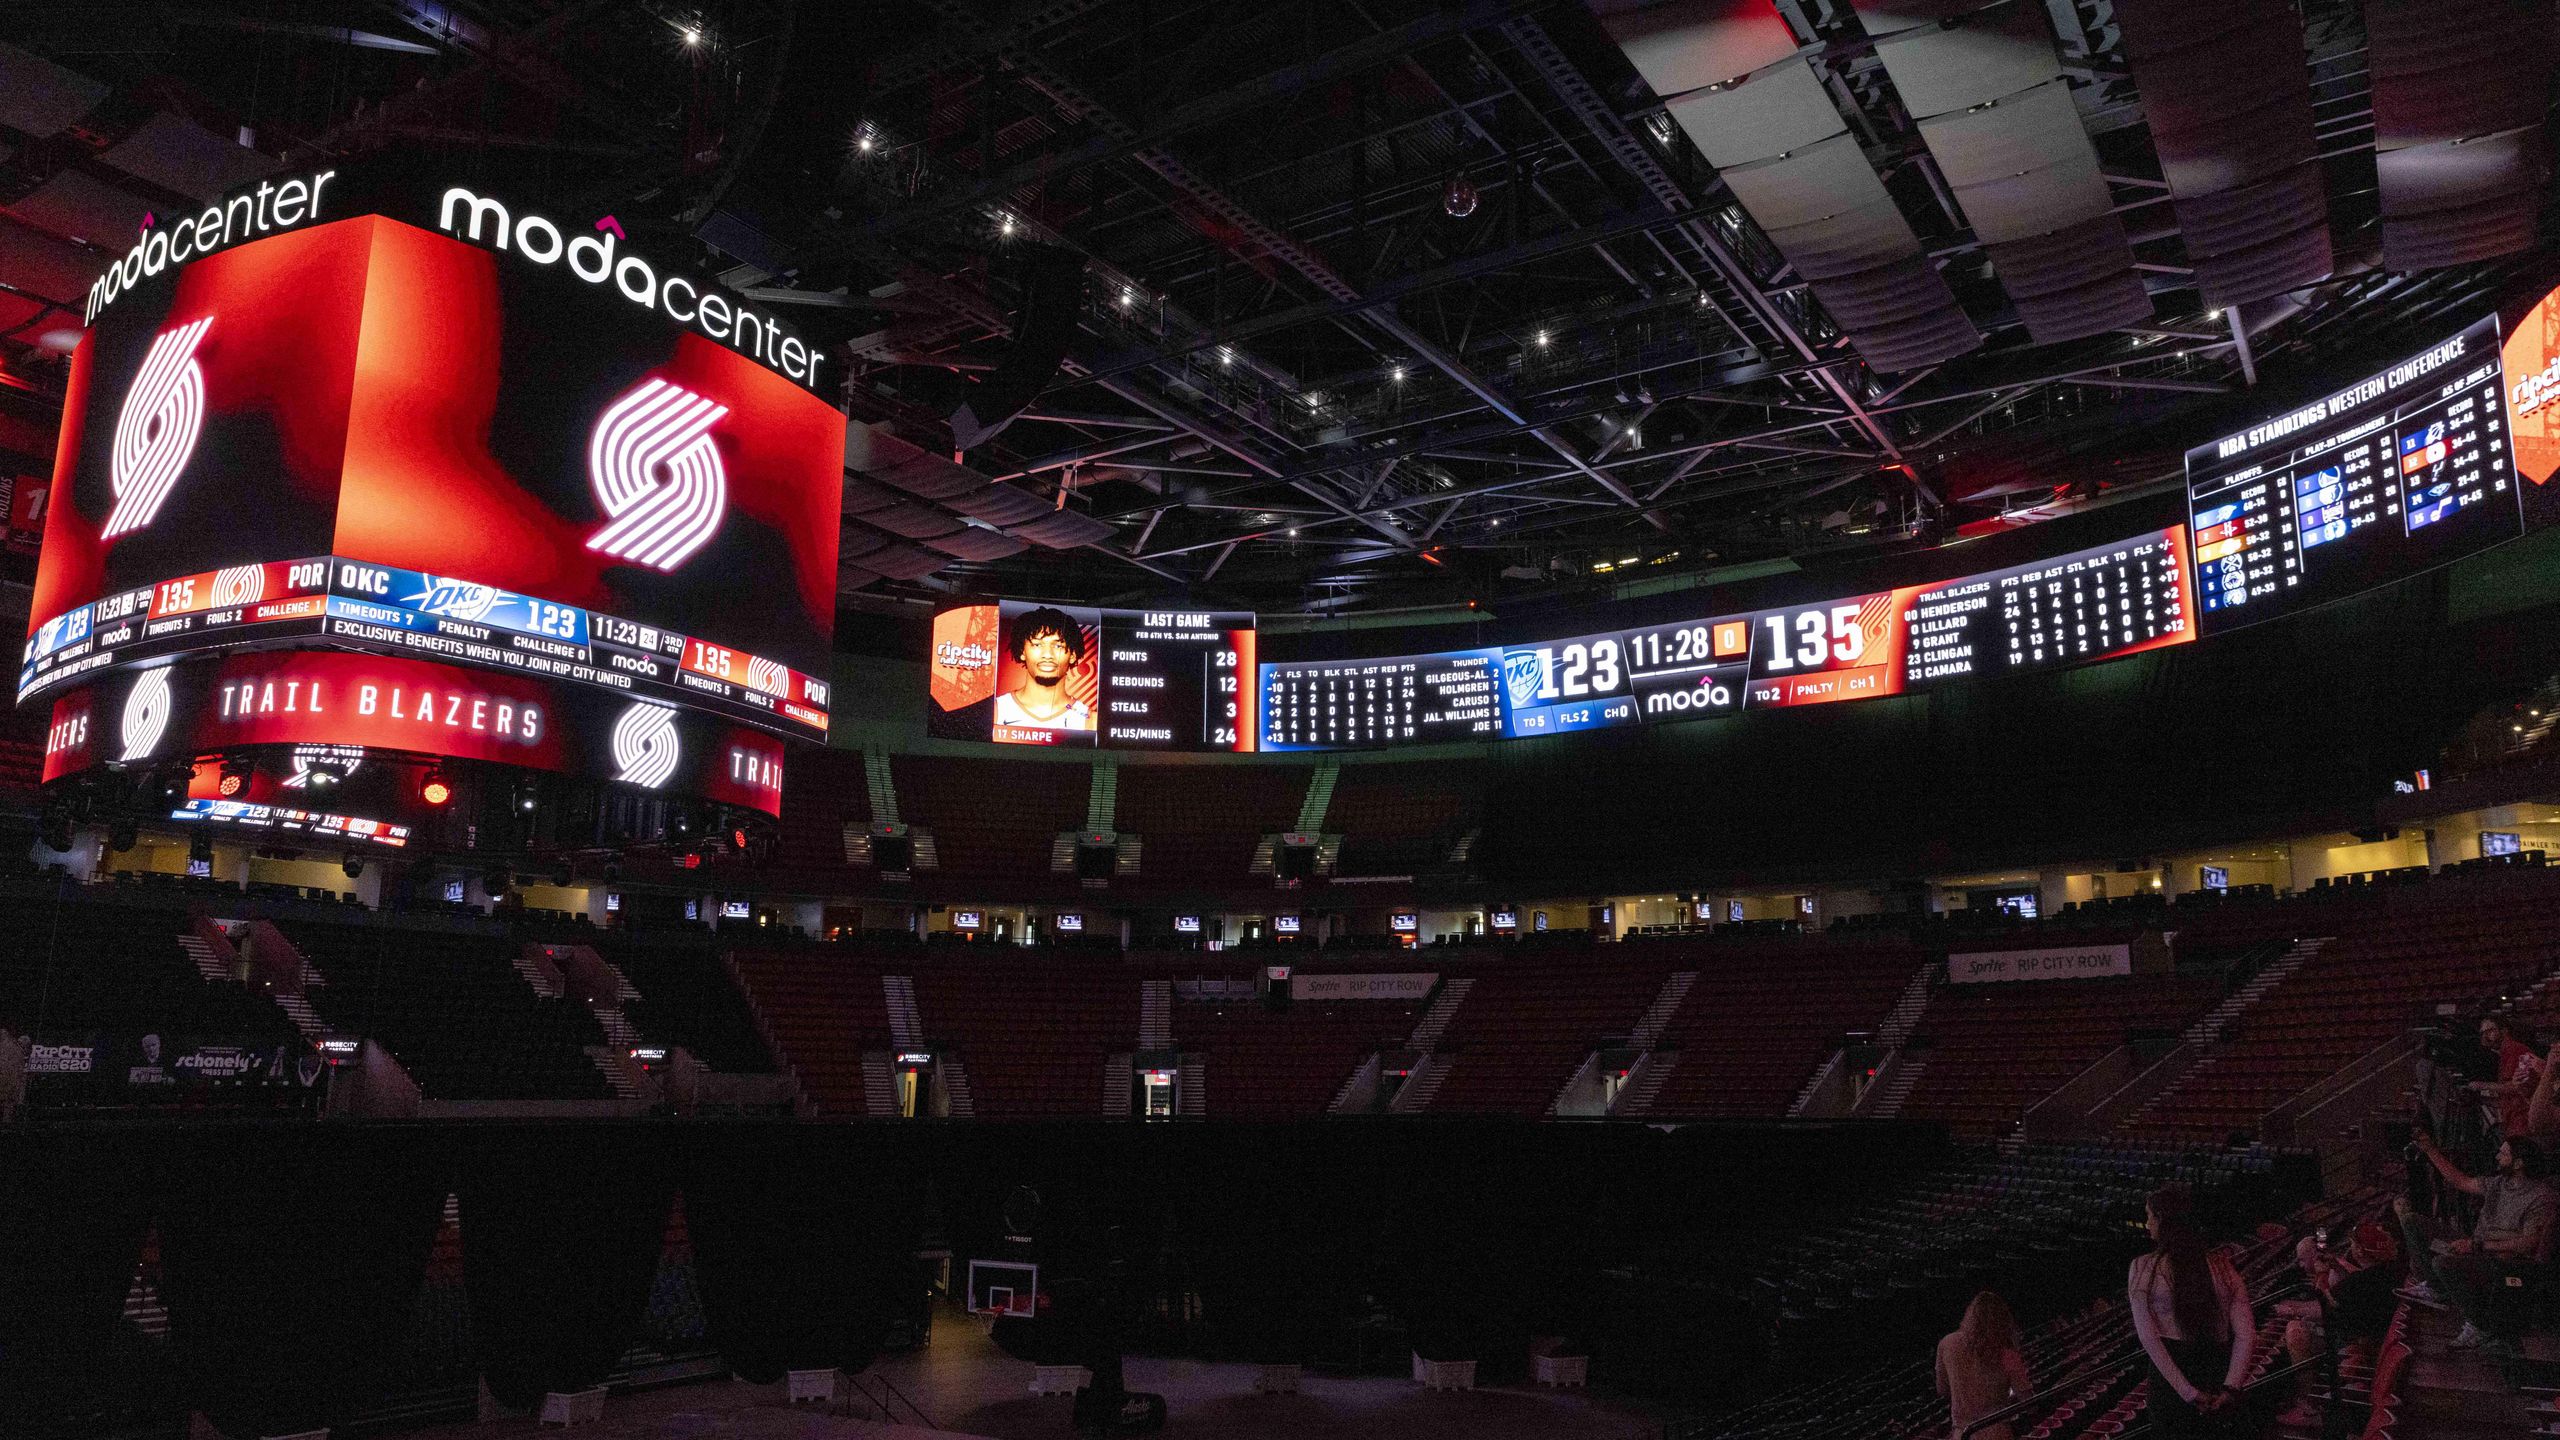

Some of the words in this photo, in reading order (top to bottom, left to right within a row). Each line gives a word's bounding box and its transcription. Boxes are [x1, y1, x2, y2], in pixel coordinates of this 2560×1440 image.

[2219, 435, 2246, 458] NBA
[2248, 402, 2326, 447] STANDINGS
[2328, 379, 2386, 416] WESTERN
[2388, 336, 2465, 388] CONFERENCE
[2441, 386, 2453, 398] AS
[2305, 439, 2335, 457] PLAY-IN
[2225, 465, 2262, 486] PLAYOFFS
[2001, 577, 2020, 588] PTS
[2021, 571, 2042, 584] REB
[2044, 566, 2064, 579] AST
[2067, 561, 2086, 574] STL
[2088, 556, 2109, 568] BLK
[2113, 551, 2128, 562] TO
[2133, 544, 2154, 557] FLS
[288, 563, 325, 589] POR
[341, 564, 391, 595] OKC
[158, 579, 195, 614] 135
[1919, 591, 1946, 603] TRAIL
[1947, 581, 1991, 600] BLAZERS
[97, 597, 121, 623] 11:23
[206, 611, 233, 625] FOULS
[235, 609, 242, 621] 2
[257, 601, 310, 618] CHALLENGE
[338, 601, 401, 623] TIMEOUTS
[405, 614, 414, 626] 7
[1903, 609, 1918, 622] 00
[1920, 596, 1988, 619] HENDERSON
[65, 608, 90, 642] 123
[525, 600, 577, 639] 123
[1144, 613, 1173, 628] LAST
[1174, 613, 1211, 629] GAME
[1910, 624, 1919, 636] 0
[1921, 615, 1968, 634] LILLARD
[438, 620, 491, 640] PENALTY
[595, 616, 637, 646] 11:23
[643, 632, 655, 645] 24
[1136, 632, 1149, 640] FEB
[1149, 632, 1162, 640] 6TH
[1163, 632, 1175, 640] VS.
[1175, 632, 1189, 640] SAN
[1190, 633, 1219, 641] ANTONIO
[1723, 629, 1735, 649] 0
[1765, 604, 1864, 671] 135
[513, 636, 576, 659] CHALLENGE
[664, 634, 683, 649] 3RD
[1631, 626, 1709, 667] 11:28
[1912, 638, 1920, 650] 9
[1922, 631, 1960, 649] GRANT
[334, 620, 404, 644] EXCLUSIVE
[406, 632, 464, 655] BENEFITS
[466, 644, 501, 662] WHEN
[503, 651, 525, 667] YOU
[525, 656, 550, 672] JOIN
[552, 661, 571, 675] RIP
[572, 666, 596, 682] CITY
[596, 670, 631, 689] UNITED
[693, 642, 732, 676] 135
[937, 640, 992, 665] ripcity
[1112, 651, 1148, 662] POINTS
[1215, 651, 1237, 667] 28
[1907, 653, 1921, 666] 23
[1923, 644, 1972, 663] CLINGAN
[612, 656, 658, 677] moda
[1286, 671, 1302, 679] FLS
[1308, 670, 1318, 678] TO
[1324, 669, 1340, 677] BLK
[1344, 668, 1359, 676] STL
[1362, 667, 1378, 675] AST
[1381, 665, 1397, 673] REB
[1401, 664, 1416, 672] PTS
[1452, 657, 1489, 668] THUNDER
[1536, 639, 1620, 699] 123
[1908, 668, 1922, 680] 33
[1924, 660, 1972, 678] CAMARA
[684, 674, 723, 693] TIMEOUTS
[724, 685, 731, 695] 5
[1111, 676, 1165, 688] REBOUNDS
[1219, 677, 1237, 692] 12
[1425, 670, 1490, 684] GILGEOUS-AL.
[1493, 668, 1499, 678] 2
[1849, 677, 1866, 690] CH
[1868, 675, 1876, 688] 1
[804, 680, 826, 705] POR
[1439, 681, 1490, 695] HOLMGREN
[1493, 681, 1499, 690] 7
[1648, 676, 1730, 713] moda
[1755, 690, 1770, 701] TO
[1771, 687, 1781, 701] 2
[1797, 681, 1834, 696] PNLTY
[745, 691, 767, 706] FOULS
[769, 698, 775, 709] 2
[1111, 701, 1148, 713] STEALS
[1226, 703, 1237, 718] 3
[1453, 695, 1490, 707] CARUSO
[1494, 694, 1500, 704] 9
[224, 682, 323, 716] TRAIL
[359, 685, 538, 738] BLAZERS
[785, 704, 819, 723] CHALLENGE
[1423, 712, 1444, 723] JAL.
[1445, 708, 1490, 721] WILLIAMS
[1494, 707, 1500, 717] 8
[1560, 712, 1580, 723] FLS
[1581, 709, 1589, 722] 2
[1604, 707, 1619, 719] CH
[1619, 704, 1628, 718] 0
[1472, 722, 1490, 732] JOE
[1494, 720, 1503, 730] 11
[1523, 717, 1536, 728] TO
[1537, 714, 1545, 727] 5
[997, 729, 1009, 740] 17
[1010, 730, 1053, 743] SHARPE
[1110, 727, 1172, 740] PLUS/MINUS
[1214, 728, 1237, 744] 24
[321, 815, 344, 828] 135
[1968, 959, 2005, 975] Sprite
[2018, 959, 2039, 972] RIP
[2043, 956, 2076, 970] CITY
[2077, 954, 2111, 968] ROW
[1308, 980, 1341, 992] Sprite
[1349, 980, 1367, 992] RIP
[1369, 980, 1396, 991] CITY
[1397, 980, 1424, 991] ROW
[59, 1058, 91, 1073] 620
